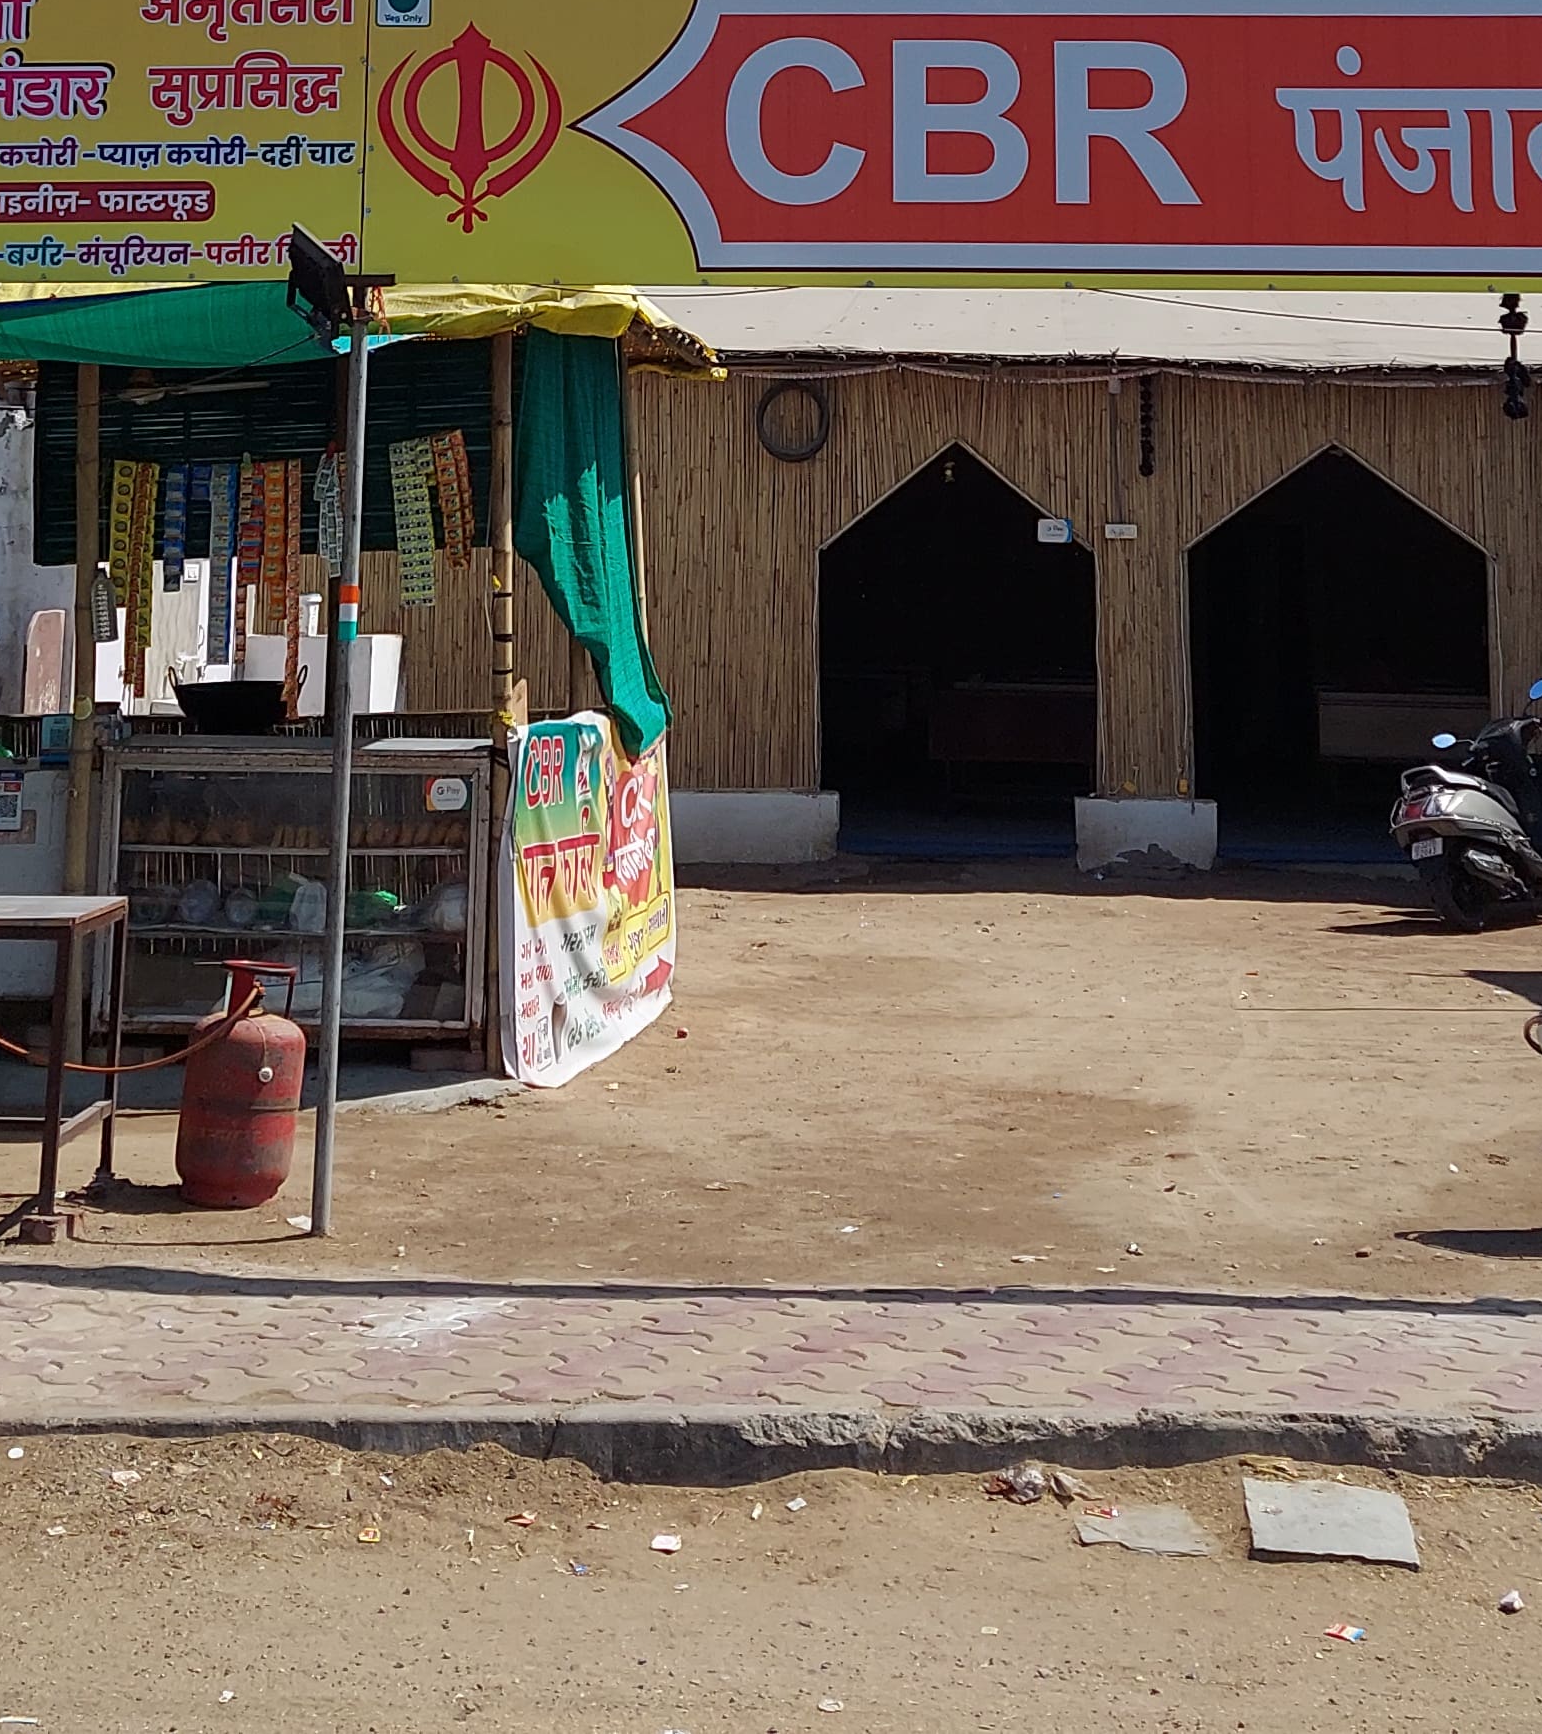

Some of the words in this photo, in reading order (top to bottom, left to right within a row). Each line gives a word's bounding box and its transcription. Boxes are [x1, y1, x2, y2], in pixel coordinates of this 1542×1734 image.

[385, 13, 401, 24] Veg
[403, 13, 424, 24] Only
[146, 50, 345, 127] सुप्रसिद्ध
[725, 36, 1203, 206] CBR
[307, 141, 357, 166] चाट
[97, 189, 212, 221] फास्टफूड
[525, 735, 566, 810] CBR
